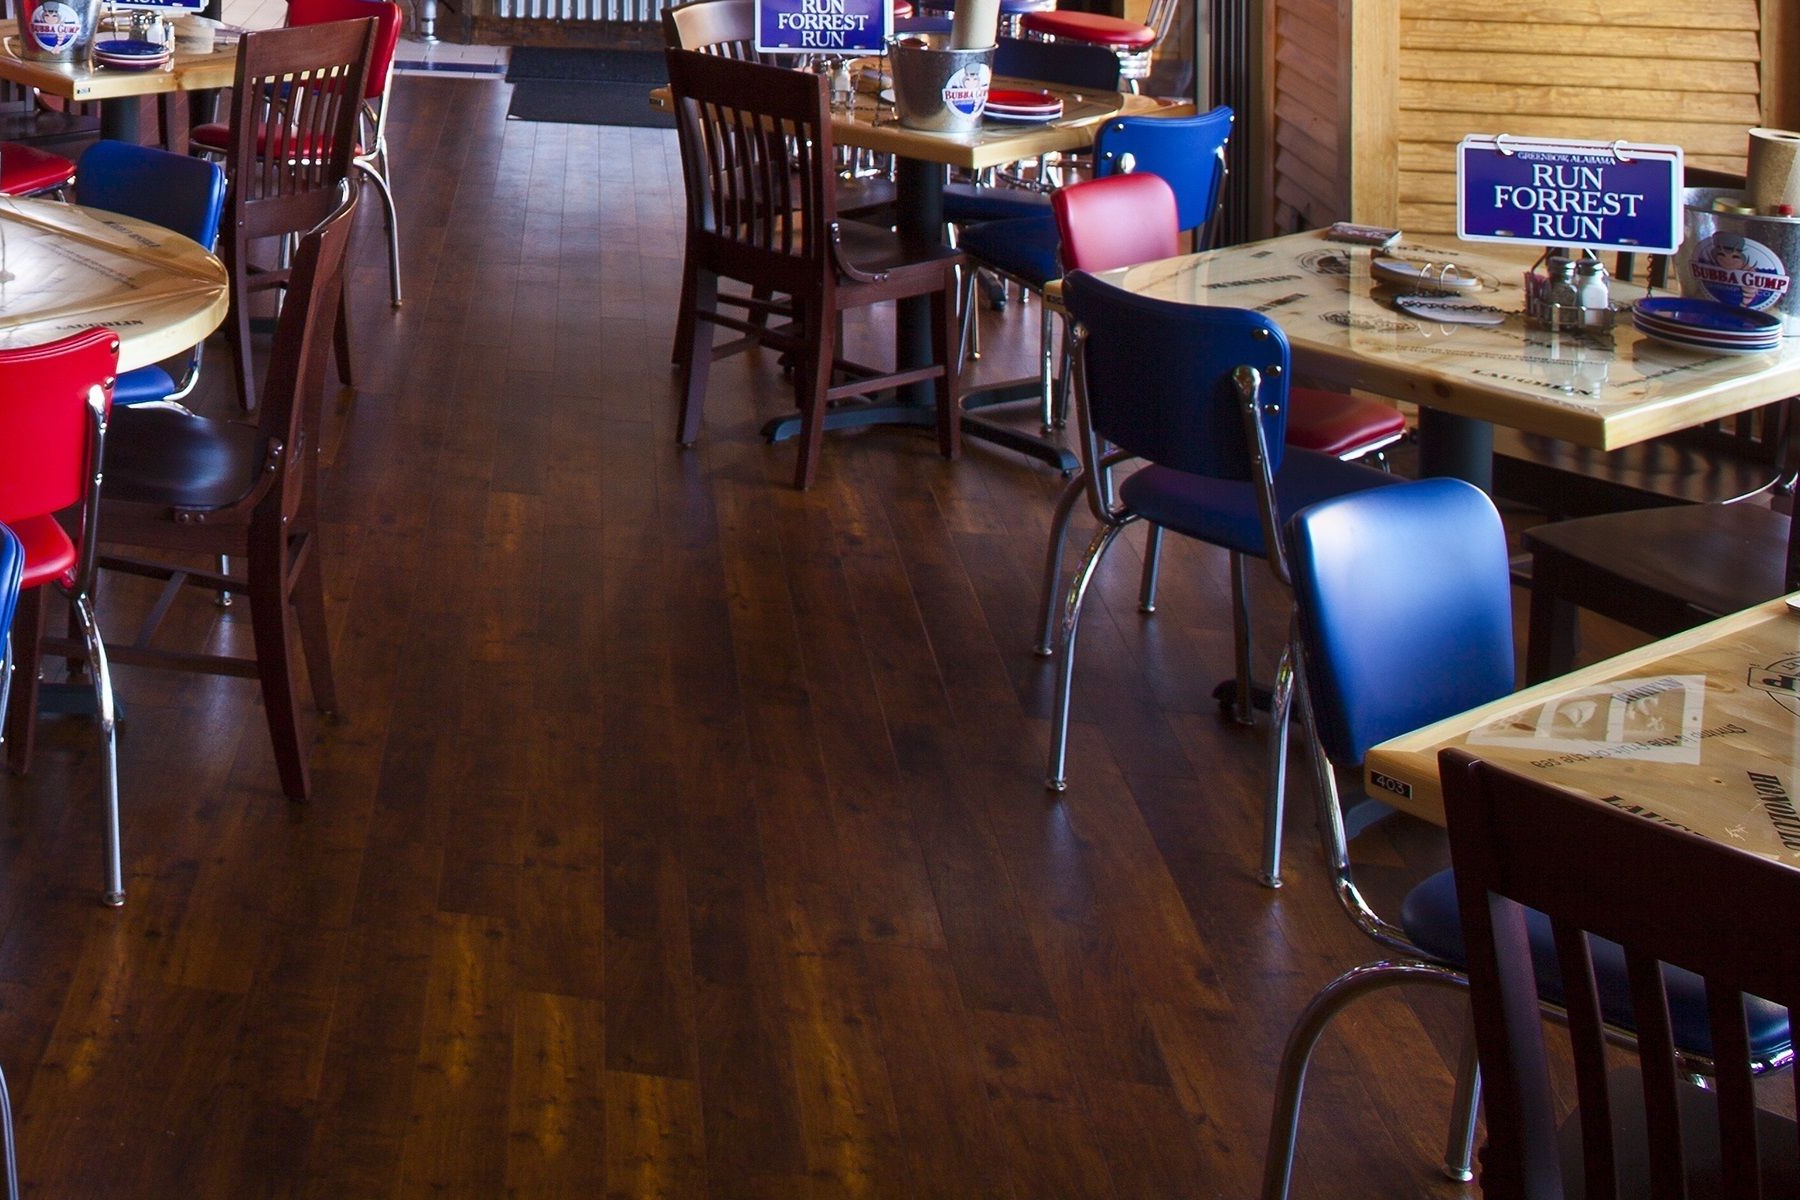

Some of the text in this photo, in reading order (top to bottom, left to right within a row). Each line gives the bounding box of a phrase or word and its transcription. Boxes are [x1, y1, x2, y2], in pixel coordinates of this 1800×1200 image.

[777, 12, 869, 32] FORREST
[800, 31, 846, 48] RUN
[1570, 152, 1617, 167] ALABAMA
[1531, 163, 1605, 191] RUN
[1493, 184, 1645, 218] FORREST
[1531, 211, 1605, 240] RUN
[1691, 261, 1789, 291] BUBBA GUMP
[1649, 735, 1679, 748] the
[1690, 722, 1747, 746] Shrimp
[1589, 742, 1613, 760] of
[1613, 737, 1650, 755] fruit
[1530, 756, 1561, 770] sea
[1561, 752, 1591, 766] the
[1374, 773, 1407, 796] 403
